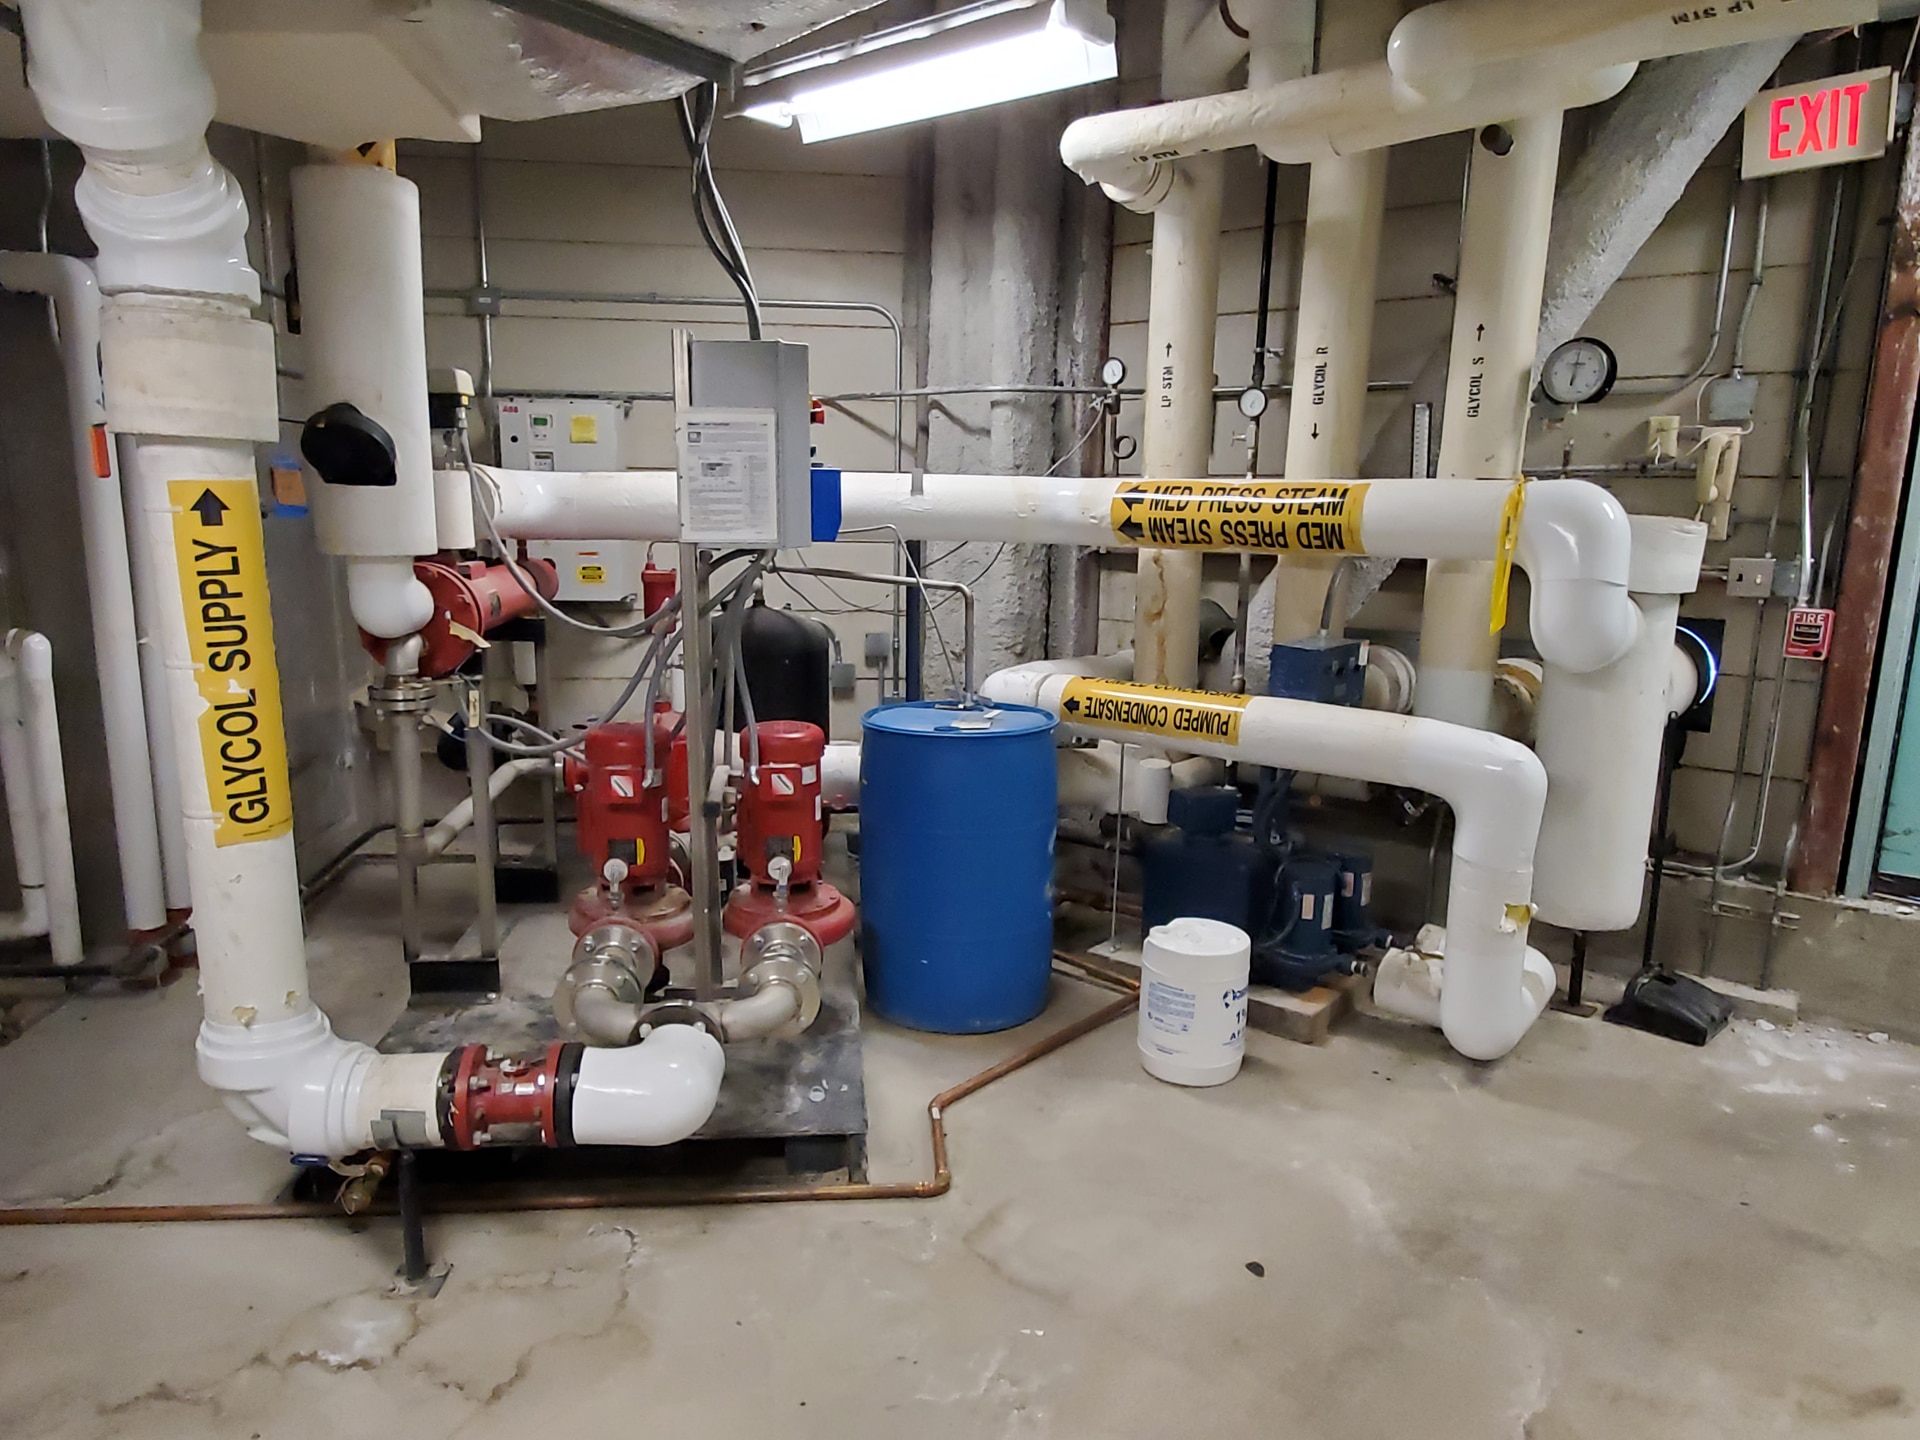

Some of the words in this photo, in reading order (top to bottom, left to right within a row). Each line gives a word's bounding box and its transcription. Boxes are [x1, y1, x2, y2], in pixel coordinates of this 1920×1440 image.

[1769, 82, 1870, 160] EXIT
[1315, 346, 1329, 355] R
[1472, 356, 1485, 365] S
[1162, 366, 1174, 390] STM
[1312, 361, 1328, 406] GLYCOL
[1160, 395, 1172, 408] LP
[1466, 372, 1484, 418] GLYCOL
[1149, 485, 1193, 512] MED
[1198, 486, 1267, 514] PRESS
[1271, 487, 1350, 517] STEAM
[1148, 516, 1214, 545] STEAM
[1220, 519, 1289, 549] PRESS
[1296, 522, 1346, 550] MED
[191, 538, 252, 673] SUPPLY
[1793, 612, 1826, 625] FIRE
[1083, 696, 1169, 728] CONDENSATE
[1173, 707, 1232, 737] PUMPED
[213, 688, 270, 825] GLYCOL
